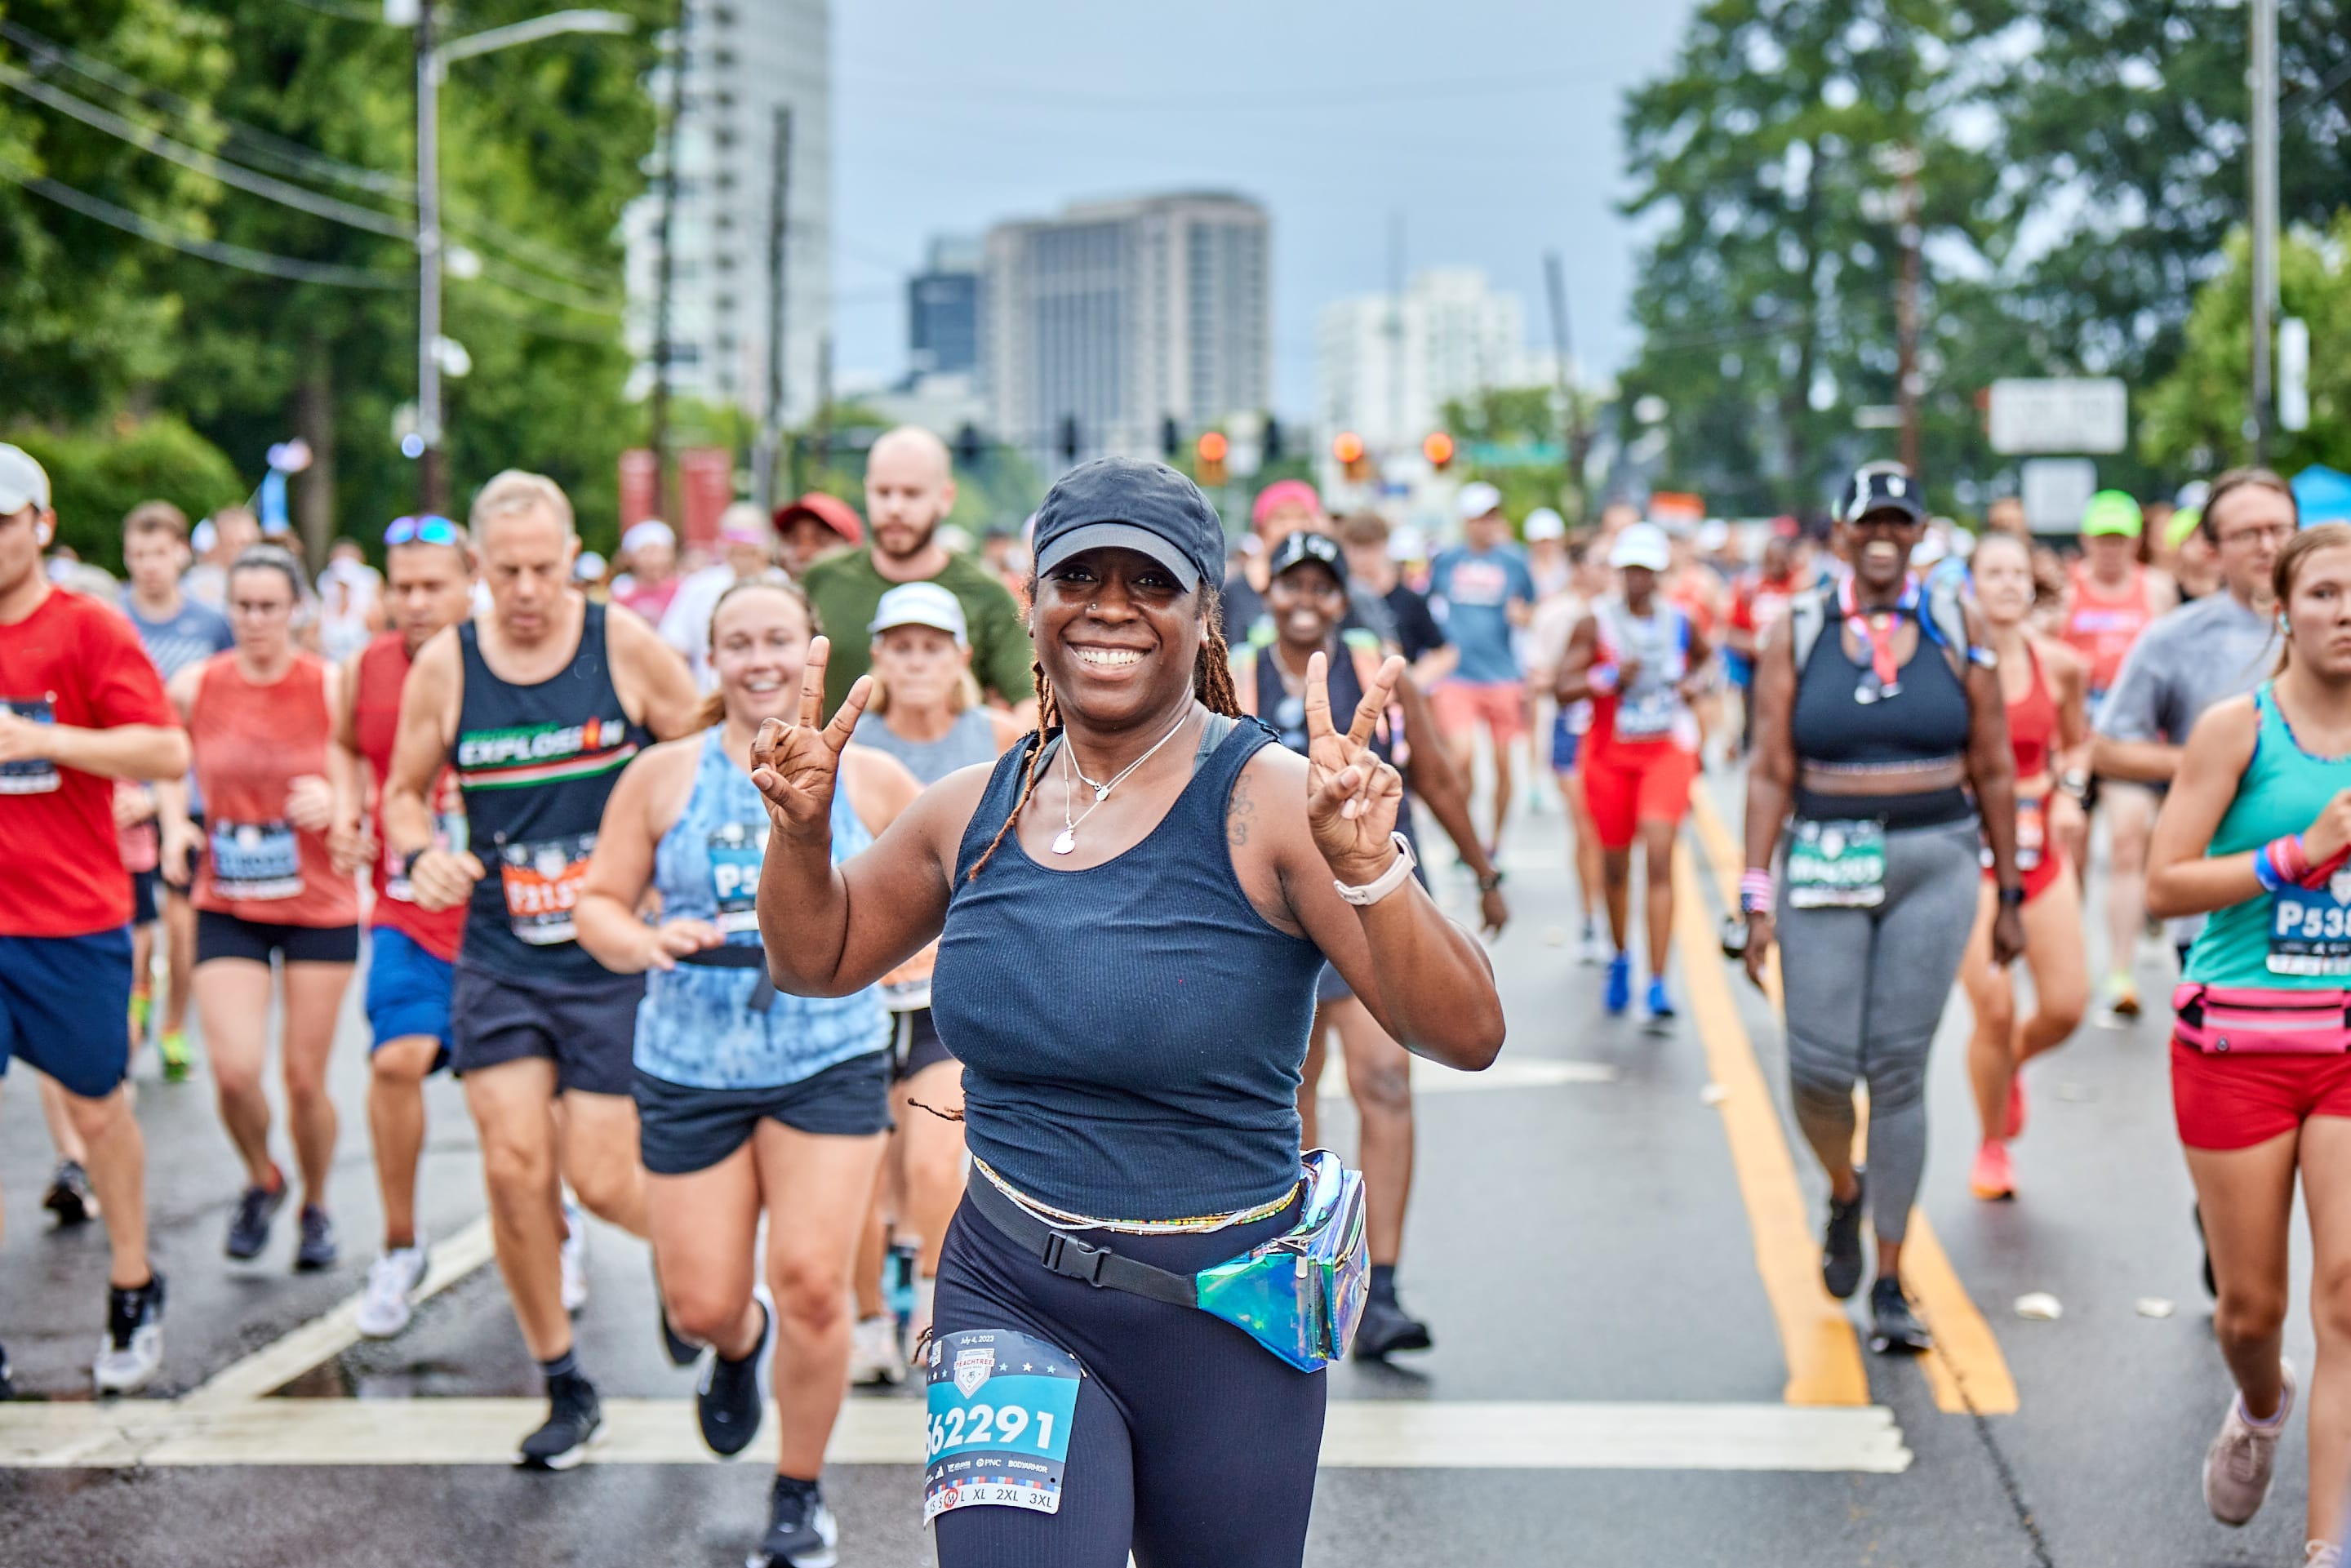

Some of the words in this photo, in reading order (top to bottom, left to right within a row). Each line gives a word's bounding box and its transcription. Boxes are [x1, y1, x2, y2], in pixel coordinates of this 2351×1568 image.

[960, 1336, 971, 1345] July
[978, 1335, 994, 1343] 2023
[955, 1358, 993, 1367] PEACHTREE
[984, 1459, 1002, 1467] PNC
[1007, 1459, 1048, 1473] BODYARMOR
[961, 1490, 965, 1502] L
[973, 1488, 986, 1500] XL
[997, 1489, 1018, 1502] 2XL
[1029, 1493, 1051, 1508] 3XL
